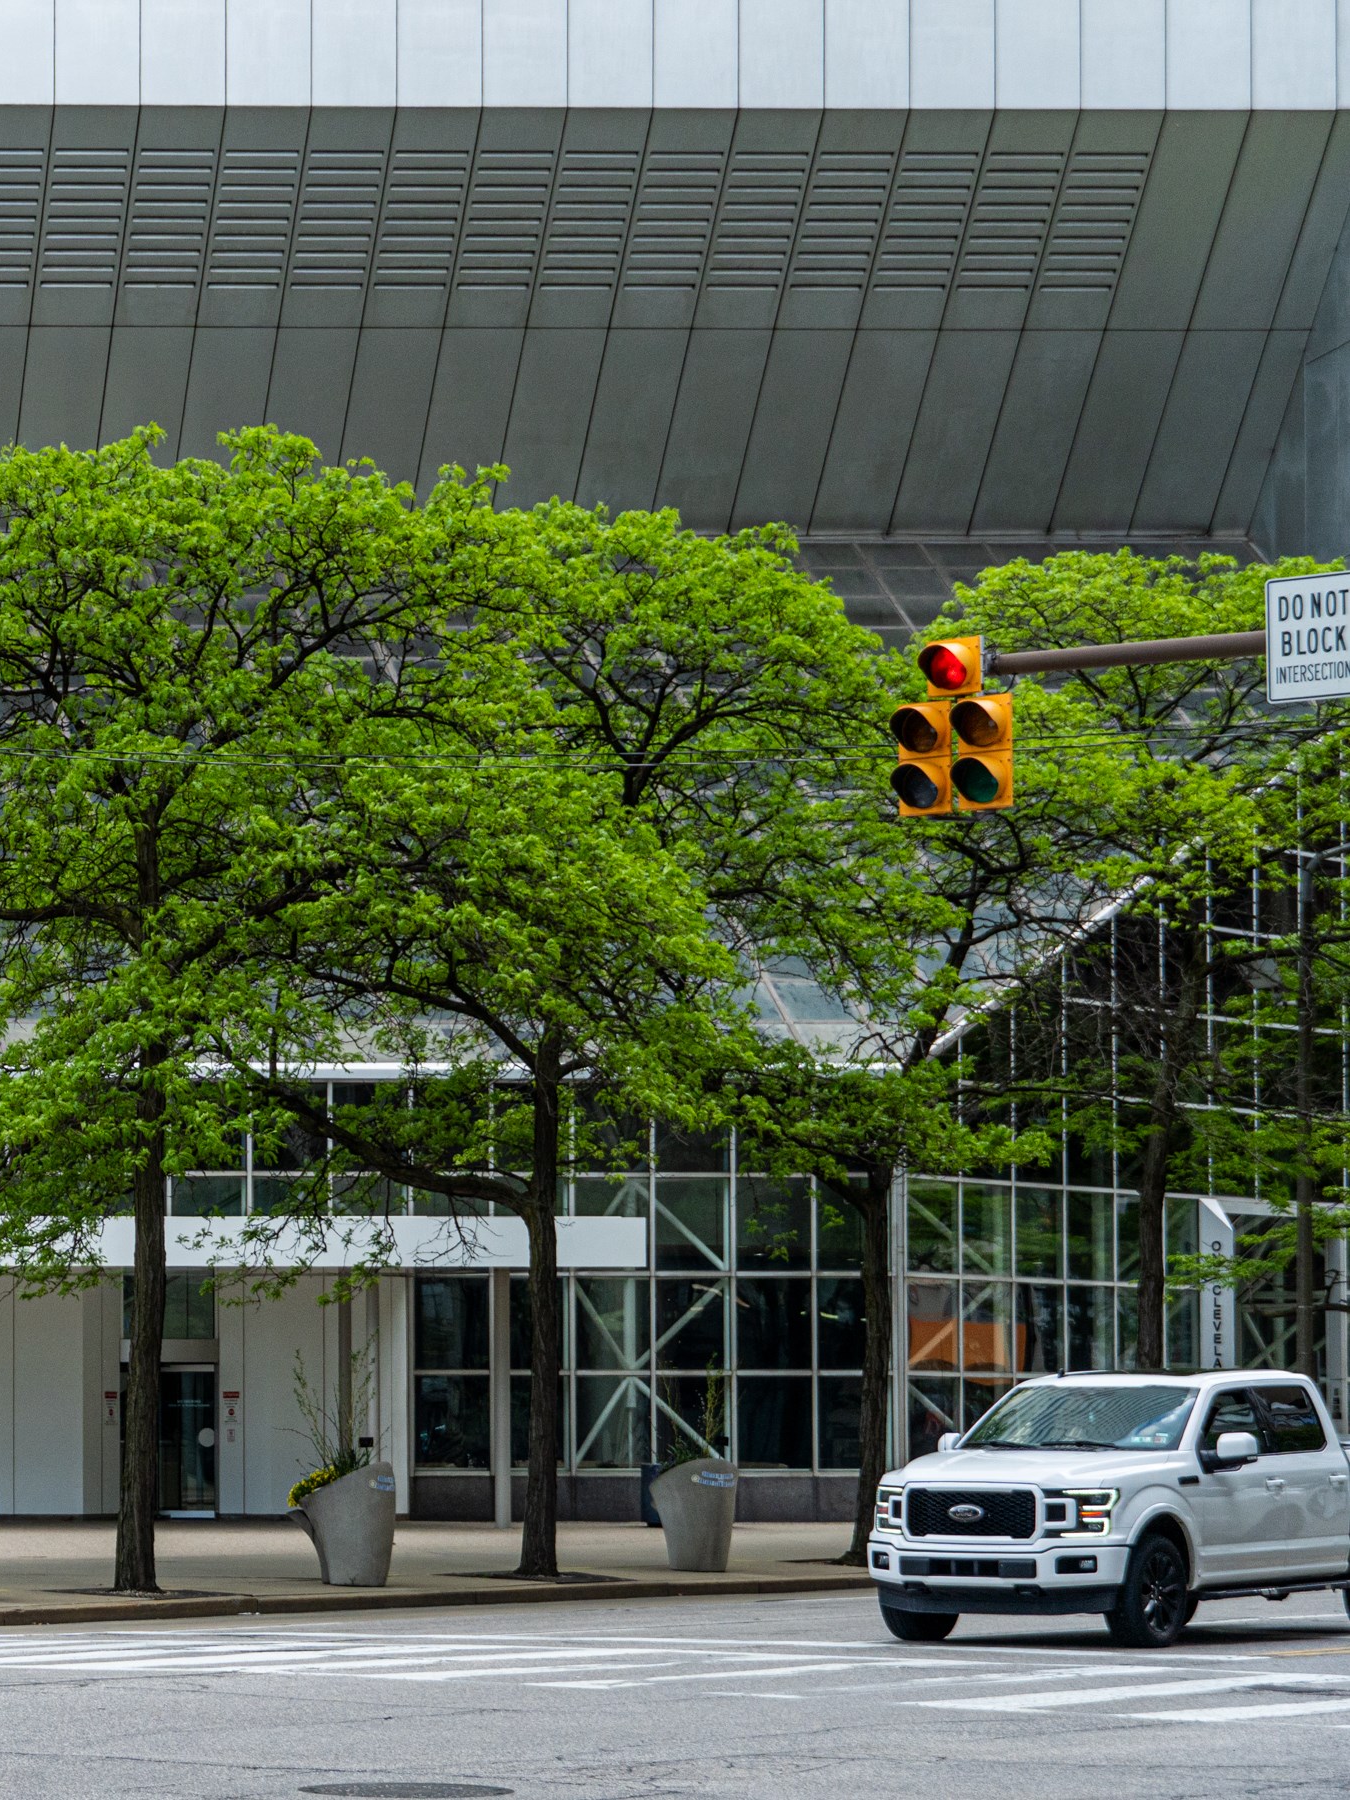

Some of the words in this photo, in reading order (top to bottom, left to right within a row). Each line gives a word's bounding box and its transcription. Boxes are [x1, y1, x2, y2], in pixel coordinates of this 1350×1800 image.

[1278, 594, 1304, 622] DO
[1310, 589, 1349, 618] NOT
[1281, 625, 1347, 657] BLOCK
[1276, 661, 1350, 684] INTERSECTION
[1212, 1284, 1222, 1369] CLEVELA
